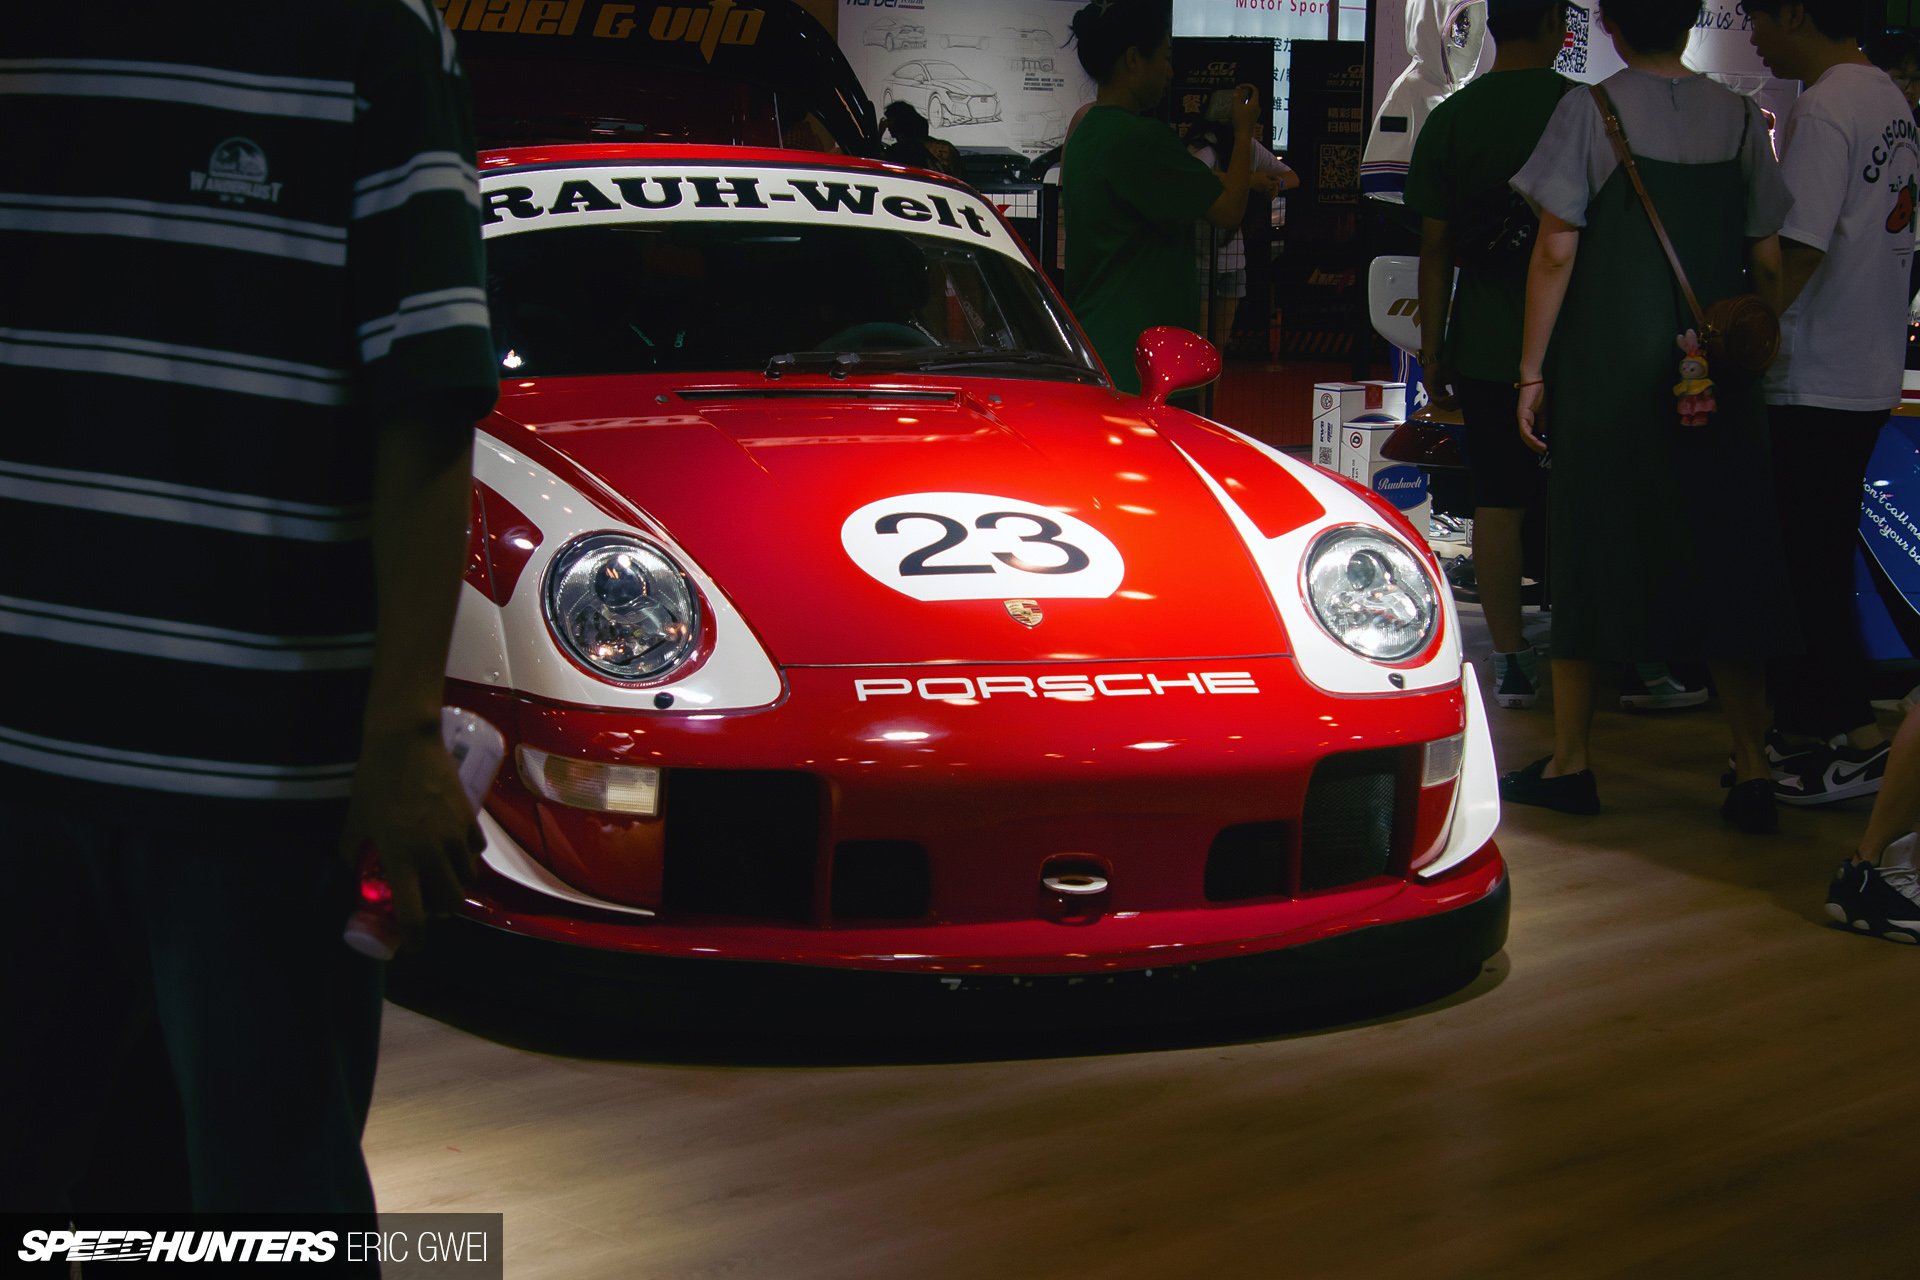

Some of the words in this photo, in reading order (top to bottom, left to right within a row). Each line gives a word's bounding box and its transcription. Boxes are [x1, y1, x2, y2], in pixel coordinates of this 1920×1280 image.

[592, 4, 637, 39] &
[1236, 0, 1283, 11] Motor
[482, 175, 992, 238] RAUH-Welt
[1863, 477, 1888, 504] on't
[1885, 502, 1909, 525] call
[875, 511, 1090, 577] 23
[1865, 507, 1887, 527] not
[1879, 524, 1909, 551] your
[854, 672, 1260, 702] PORSCHE
